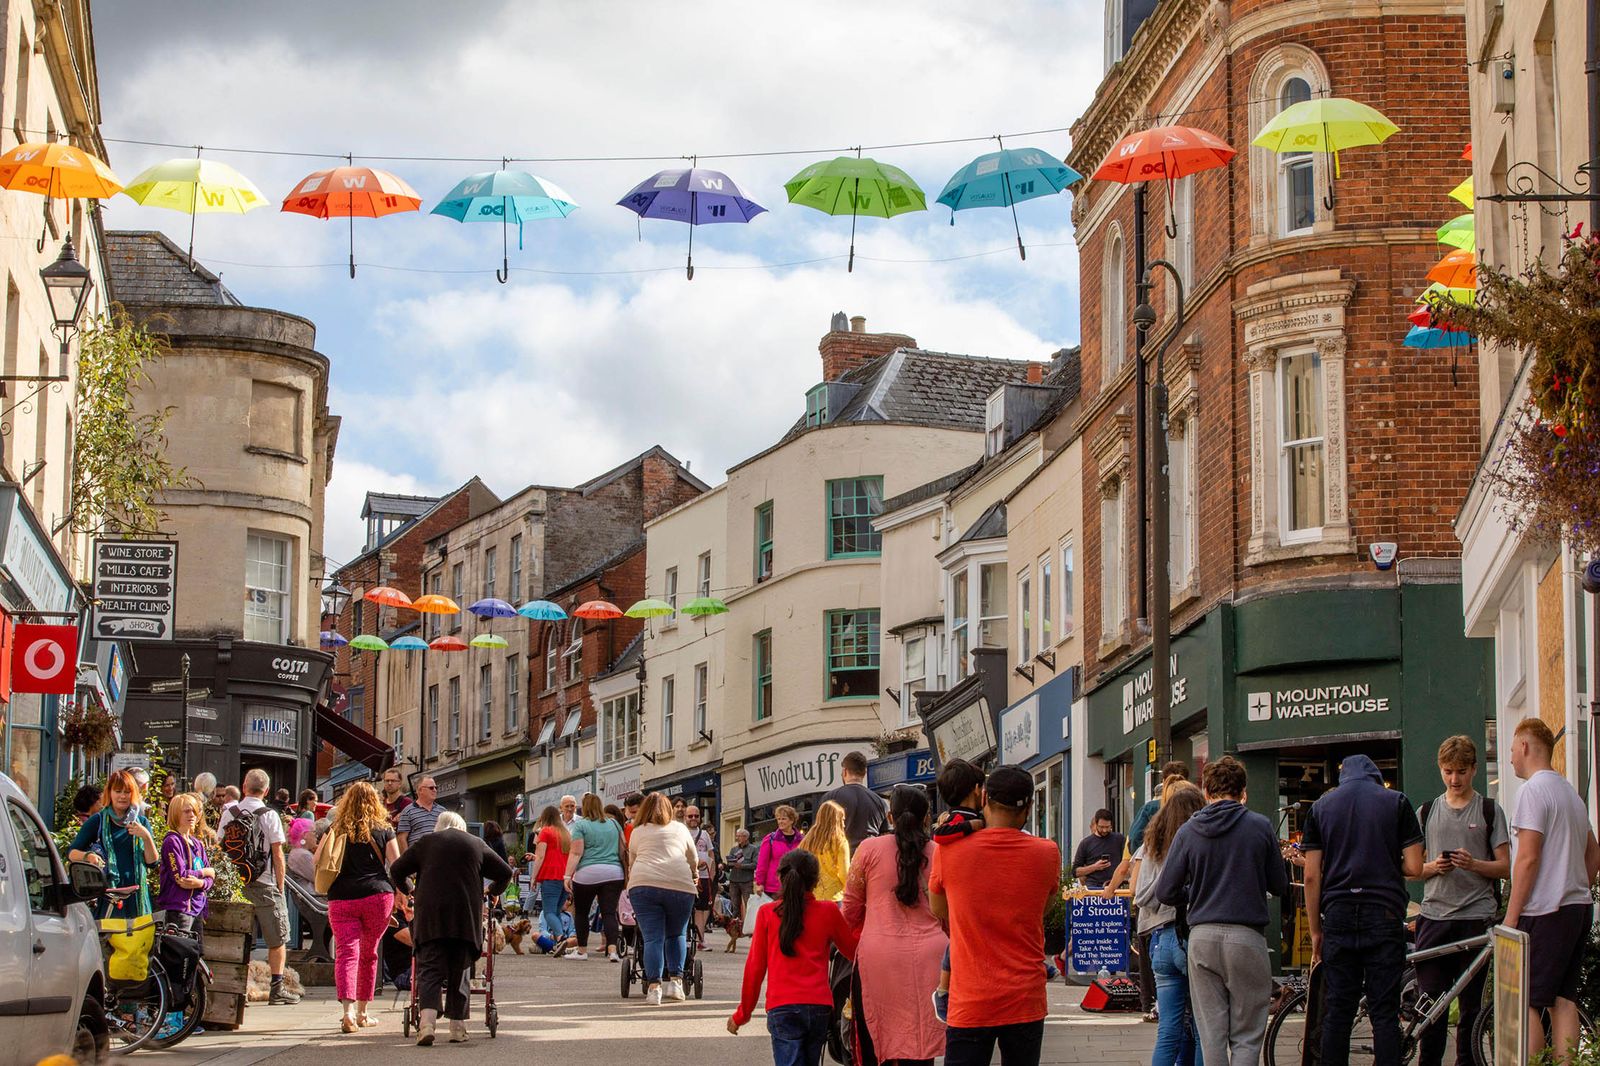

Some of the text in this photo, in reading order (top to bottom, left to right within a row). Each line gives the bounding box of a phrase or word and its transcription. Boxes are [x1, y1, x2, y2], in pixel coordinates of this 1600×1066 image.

[107, 547, 165, 559] WINE STORE
[106, 564, 164, 577] MILLS CAFE
[110, 582, 158, 595] INTERIORS
[101, 599, 168, 613] HEALTH CLINIC
[129, 620, 155, 632] SHOPS
[271, 656, 310, 674] COSTA
[277, 672, 300, 682] COFFEE
[1134, 652, 1178, 700] MOUN
[1276, 683, 1370, 704] MOUNTAIN
[1275, 697, 1390, 719] WAREHOUSE
[1072, 895, 1123, 906] INTRIGUE
[1072, 905, 1123, 917] of Stroud
